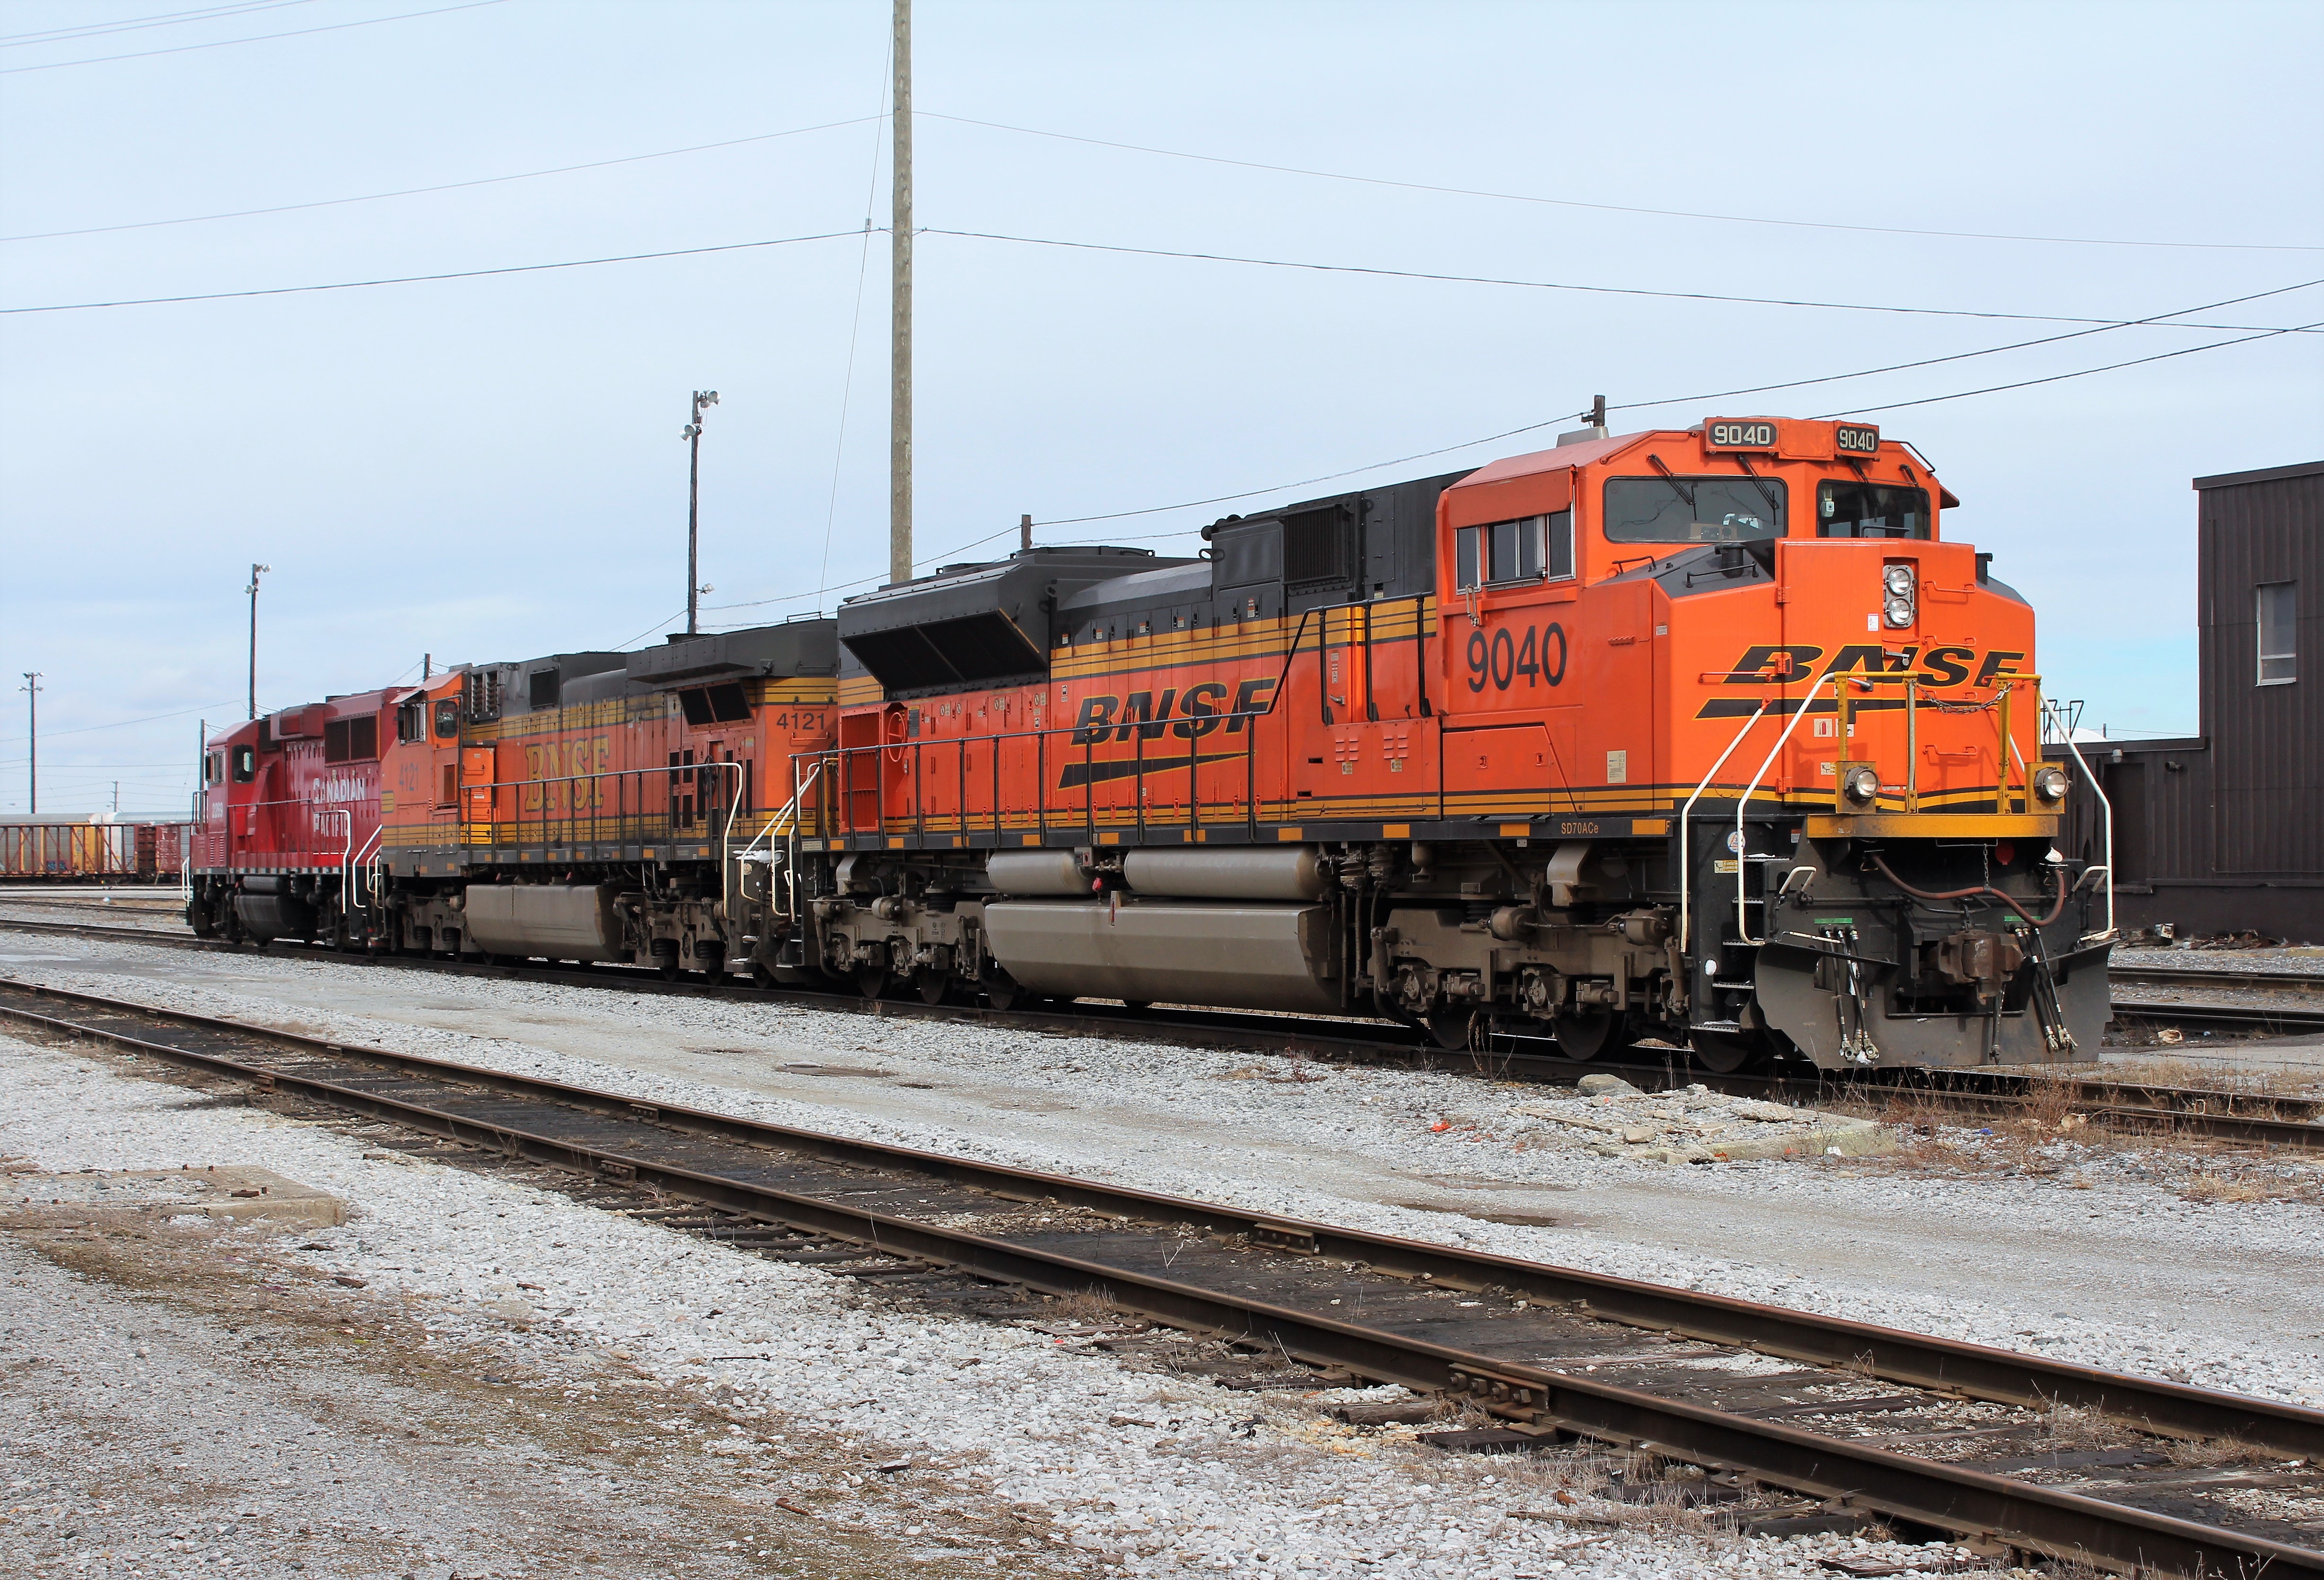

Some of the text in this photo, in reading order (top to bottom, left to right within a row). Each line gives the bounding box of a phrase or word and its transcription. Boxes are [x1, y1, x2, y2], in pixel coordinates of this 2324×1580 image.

[1715, 425, 1771, 444] 9040
[1839, 429, 1874, 451] 9040
[1467, 622, 1567, 693] 9040
[1722, 644, 2027, 688] BNSF
[776, 712, 825, 730] 4121
[1070, 676, 1279, 747] BNSF
[399, 762, 418, 791] 4121
[525, 735, 609, 812] BNSF
[313, 778, 365, 804] CANADIAN
[1561, 822, 1599, 834] SD70ACe
